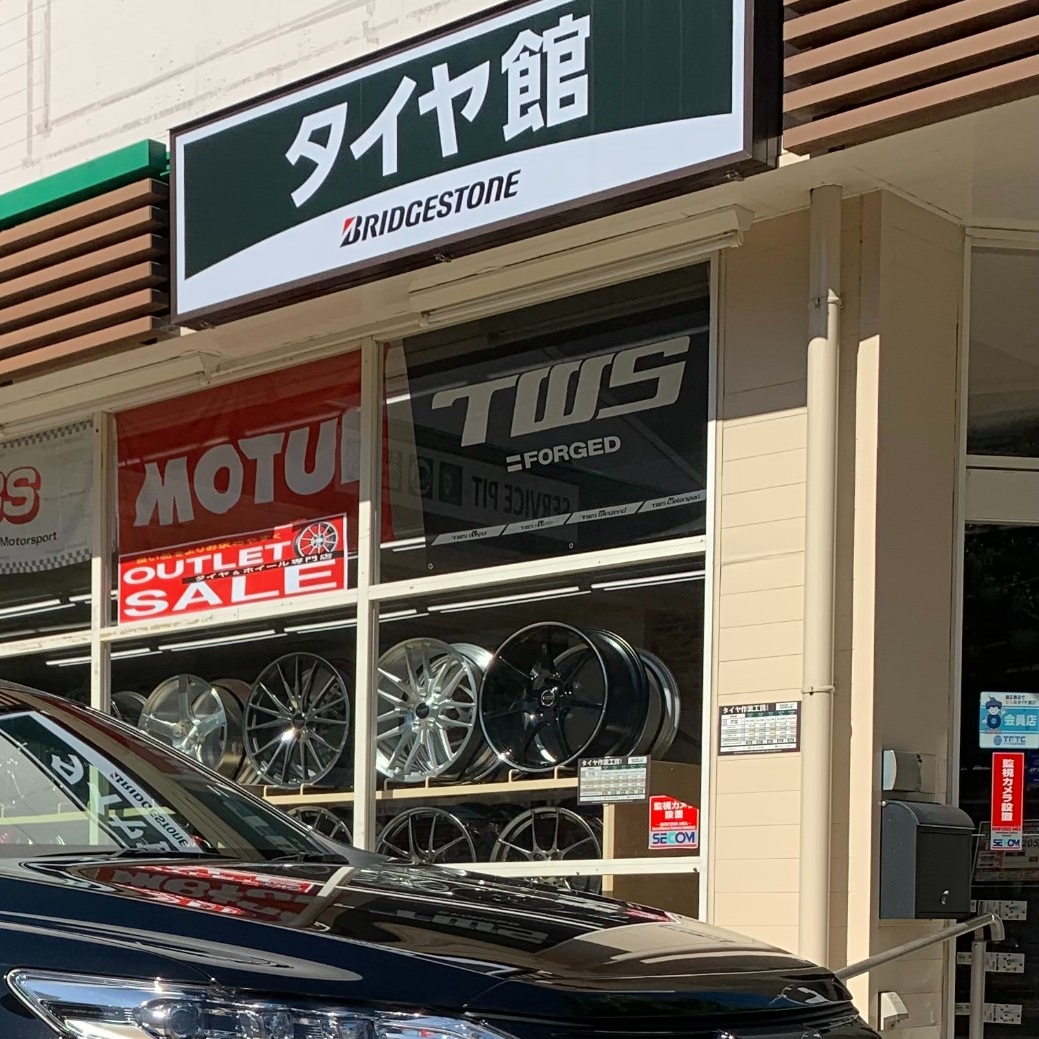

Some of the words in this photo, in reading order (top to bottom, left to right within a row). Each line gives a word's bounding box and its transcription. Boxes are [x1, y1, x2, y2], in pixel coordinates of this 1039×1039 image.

[285, 13, 591, 207] タイヤ館
[340, 169, 521, 248] BRIDGESTONE
[431, 336, 690, 447] TWS
[523, 435, 622, 470] FORGED
[0, 531, 58, 547] Motorsport
[123, 541, 291, 585] OUTLET
[123, 559, 337, 617] SALE
[1004, 713, 1037, 727] 会員店
[1001, 758, 1015, 822] 監視カメラ設置
[652, 831, 696, 845] SECOM
[993, 838, 1021, 847] SECOM
